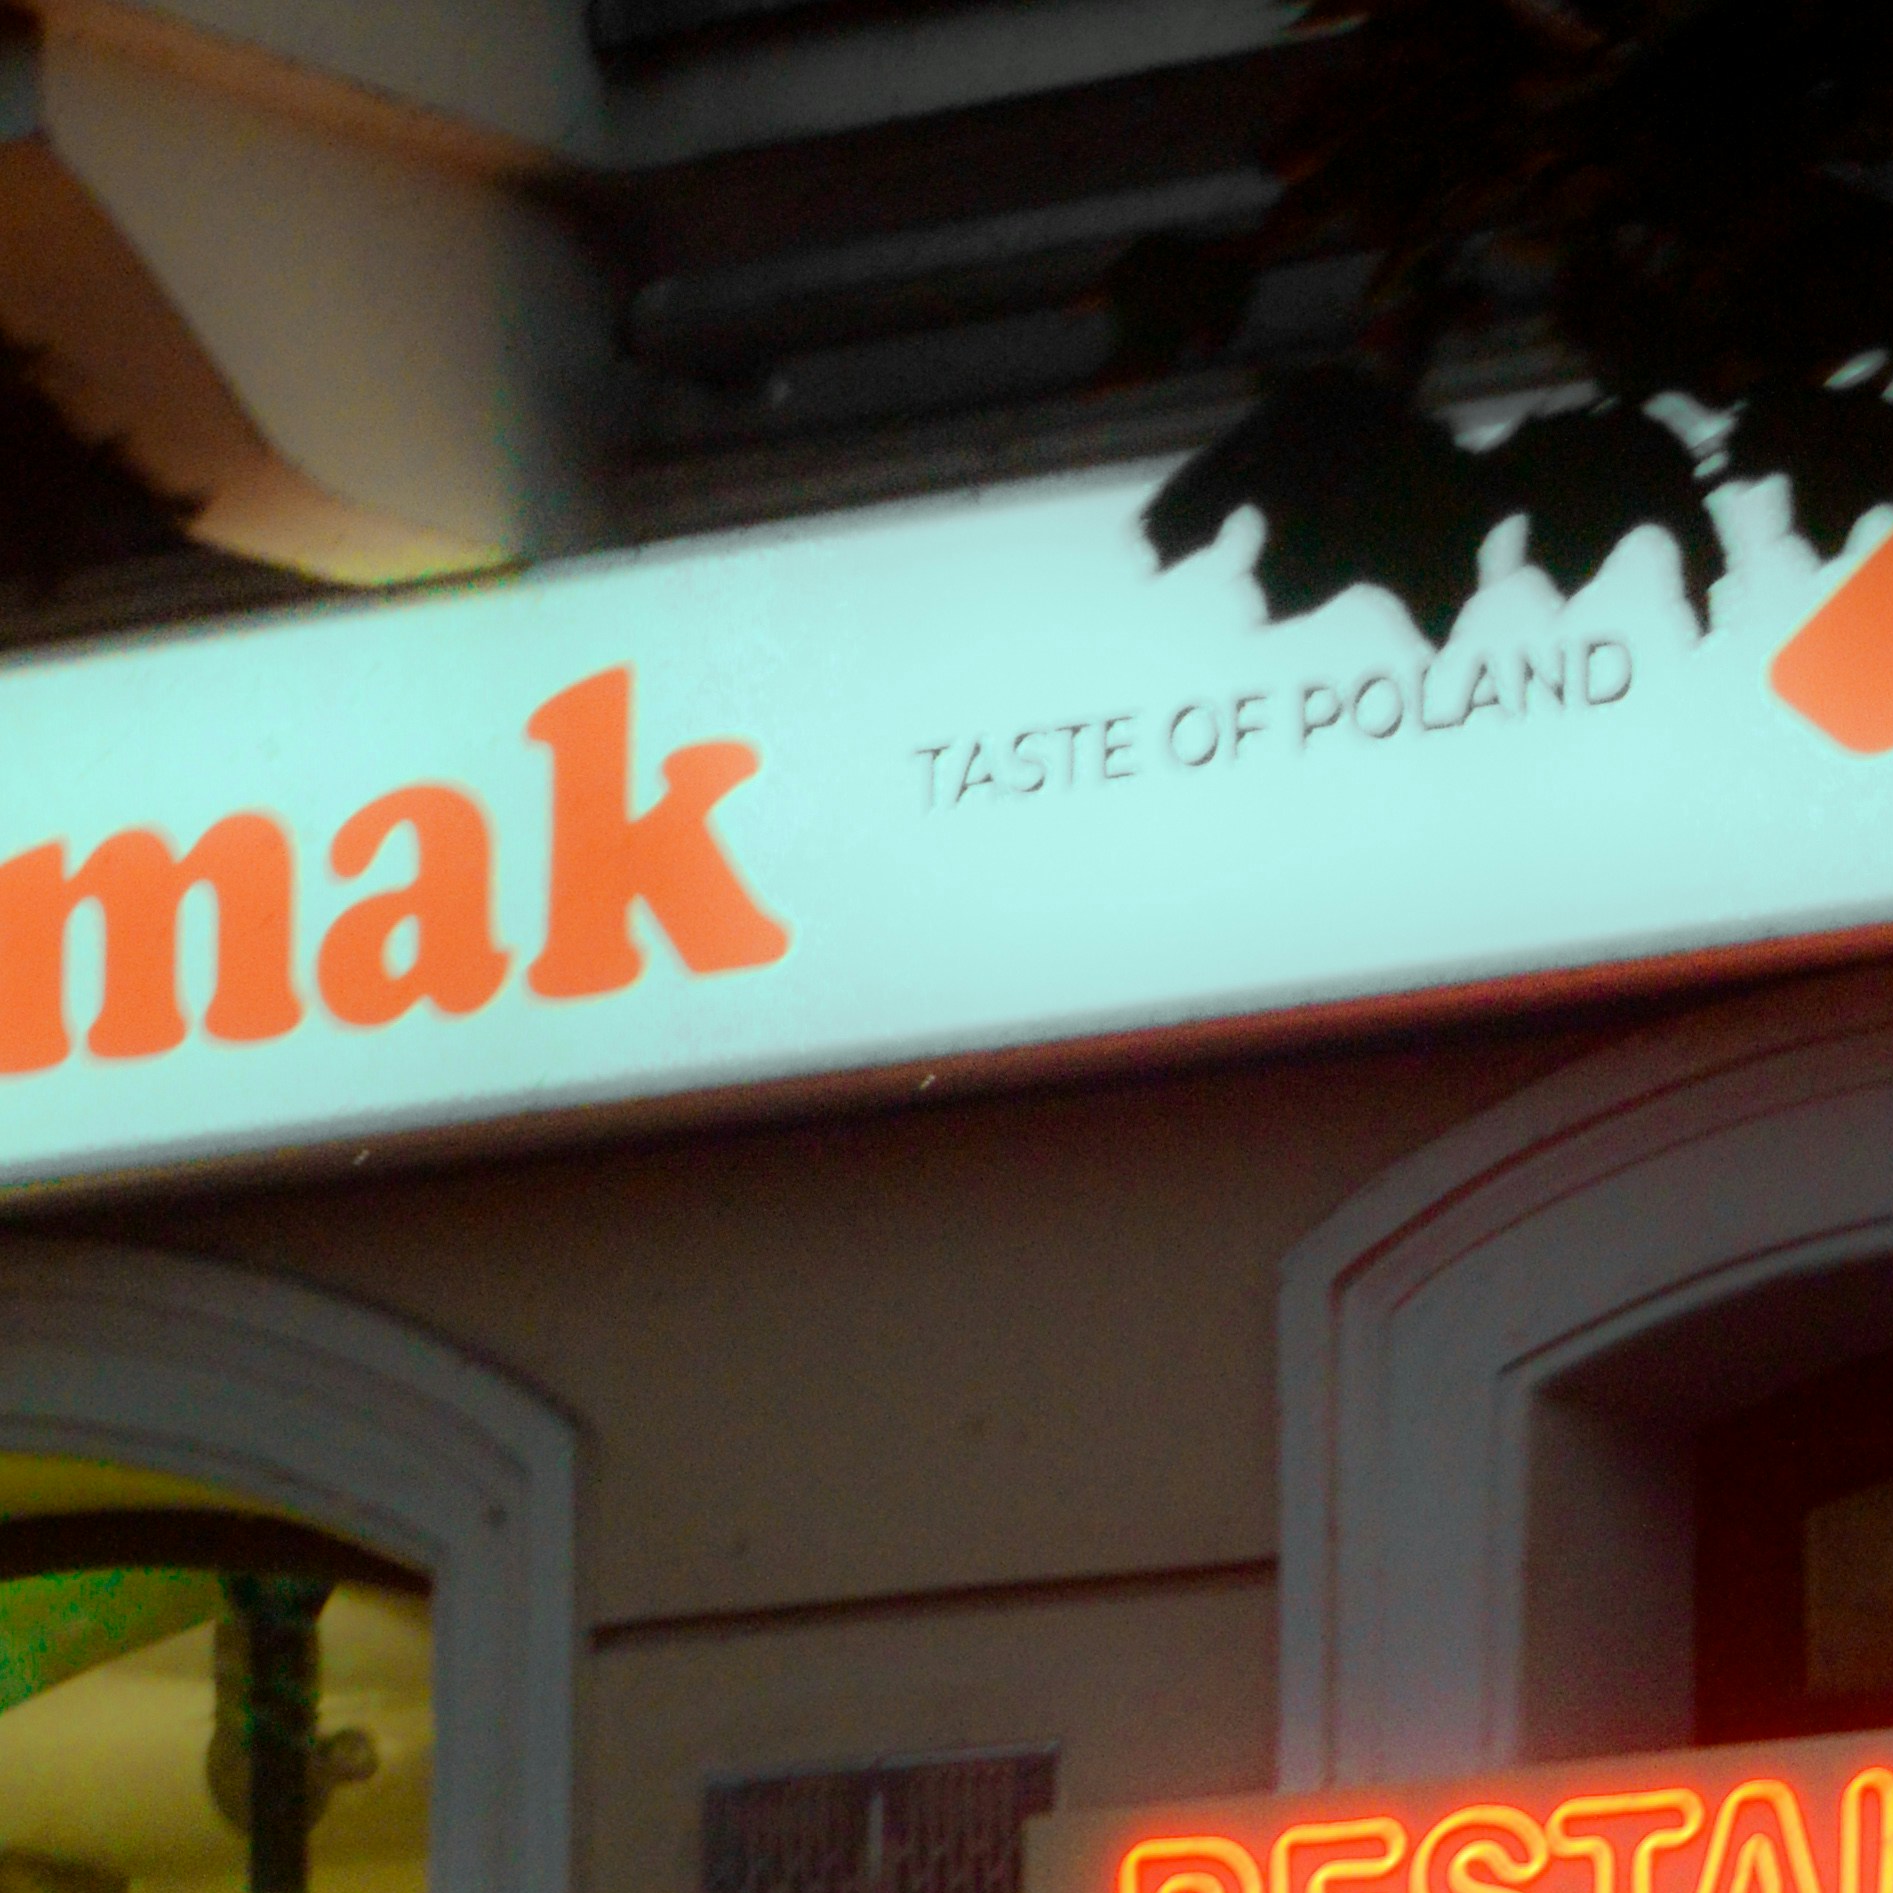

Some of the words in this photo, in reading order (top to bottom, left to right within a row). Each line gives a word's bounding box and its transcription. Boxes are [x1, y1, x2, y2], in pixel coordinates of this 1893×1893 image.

[0, 664, 789, 1076] mak
[914, 714, 1138, 815] TASTE
[1168, 693, 1269, 768] OF
[1299, 639, 1634, 748] POLAND
